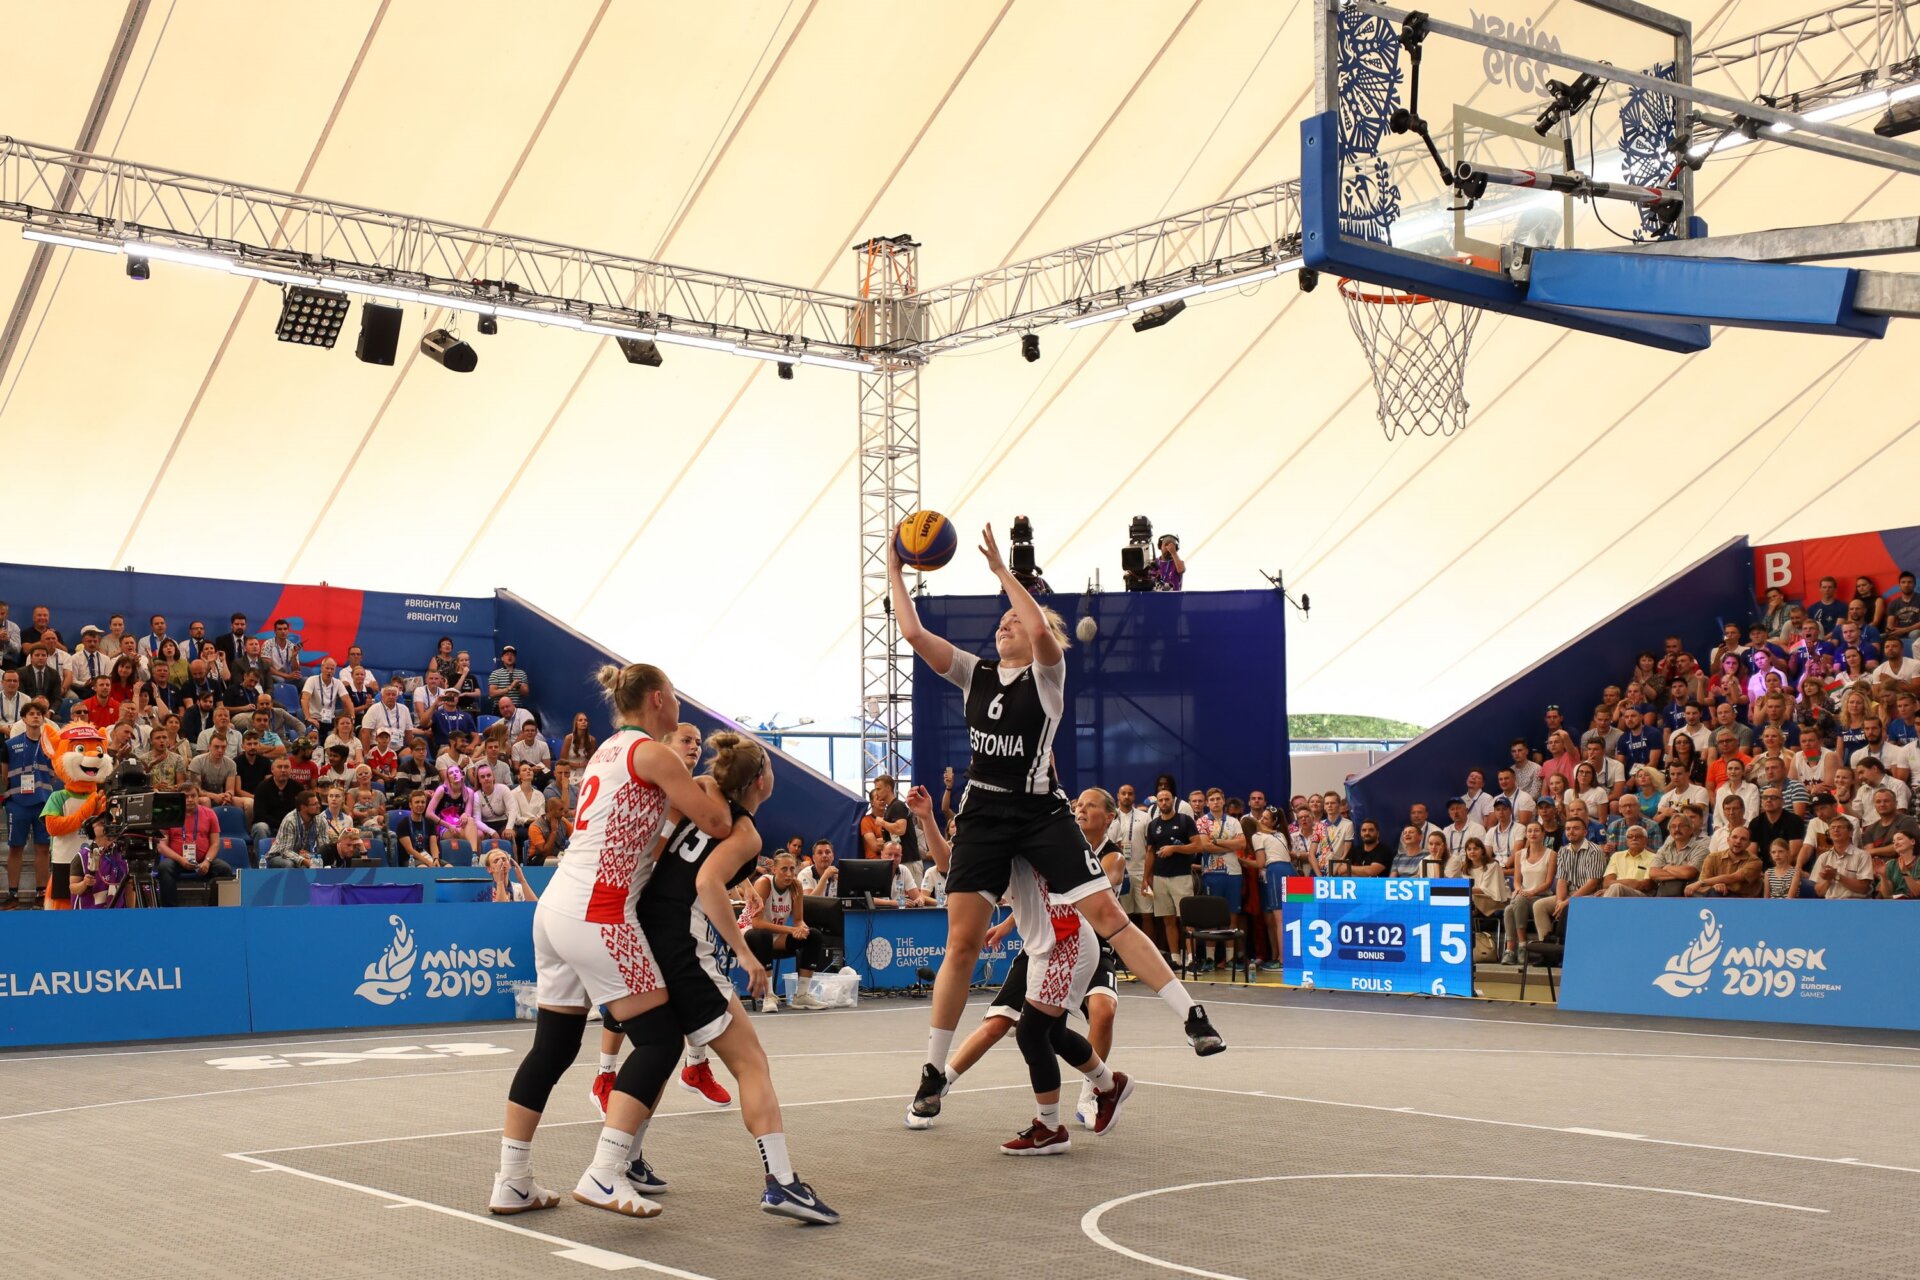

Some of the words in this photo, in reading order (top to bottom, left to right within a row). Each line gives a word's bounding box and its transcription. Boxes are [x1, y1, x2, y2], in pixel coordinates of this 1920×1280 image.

[1765, 552, 1793, 589] B
[404, 598, 461, 610] #BRIGHTYEAR
[406, 612, 458, 623] #BRIGHTYOU
[987, 692, 1005, 720] 6
[969, 725, 1025, 757] ESTONIA
[1084, 850, 1102, 876] 6
[1315, 879, 1357, 900] BLR
[1385, 880, 1429, 901] EST
[896, 937, 914, 947] THE
[1285, 919, 1333, 958] 13
[1340, 924, 1403, 946] 01:02
[1412, 923, 1467, 964] 15
[896, 957, 929, 967] GAMES
[1357, 951, 1385, 960] BONUS
[423, 969, 492, 998] 2019
[1302, 970, 1314, 987] 5
[1351, 977, 1393, 992] FOULS
[1431, 977, 1447, 996] 6
[1722, 967, 1796, 998] 2019
[1801, 983, 1842, 991] EUROPEAN
[1800, 991, 1825, 999] GAMES
